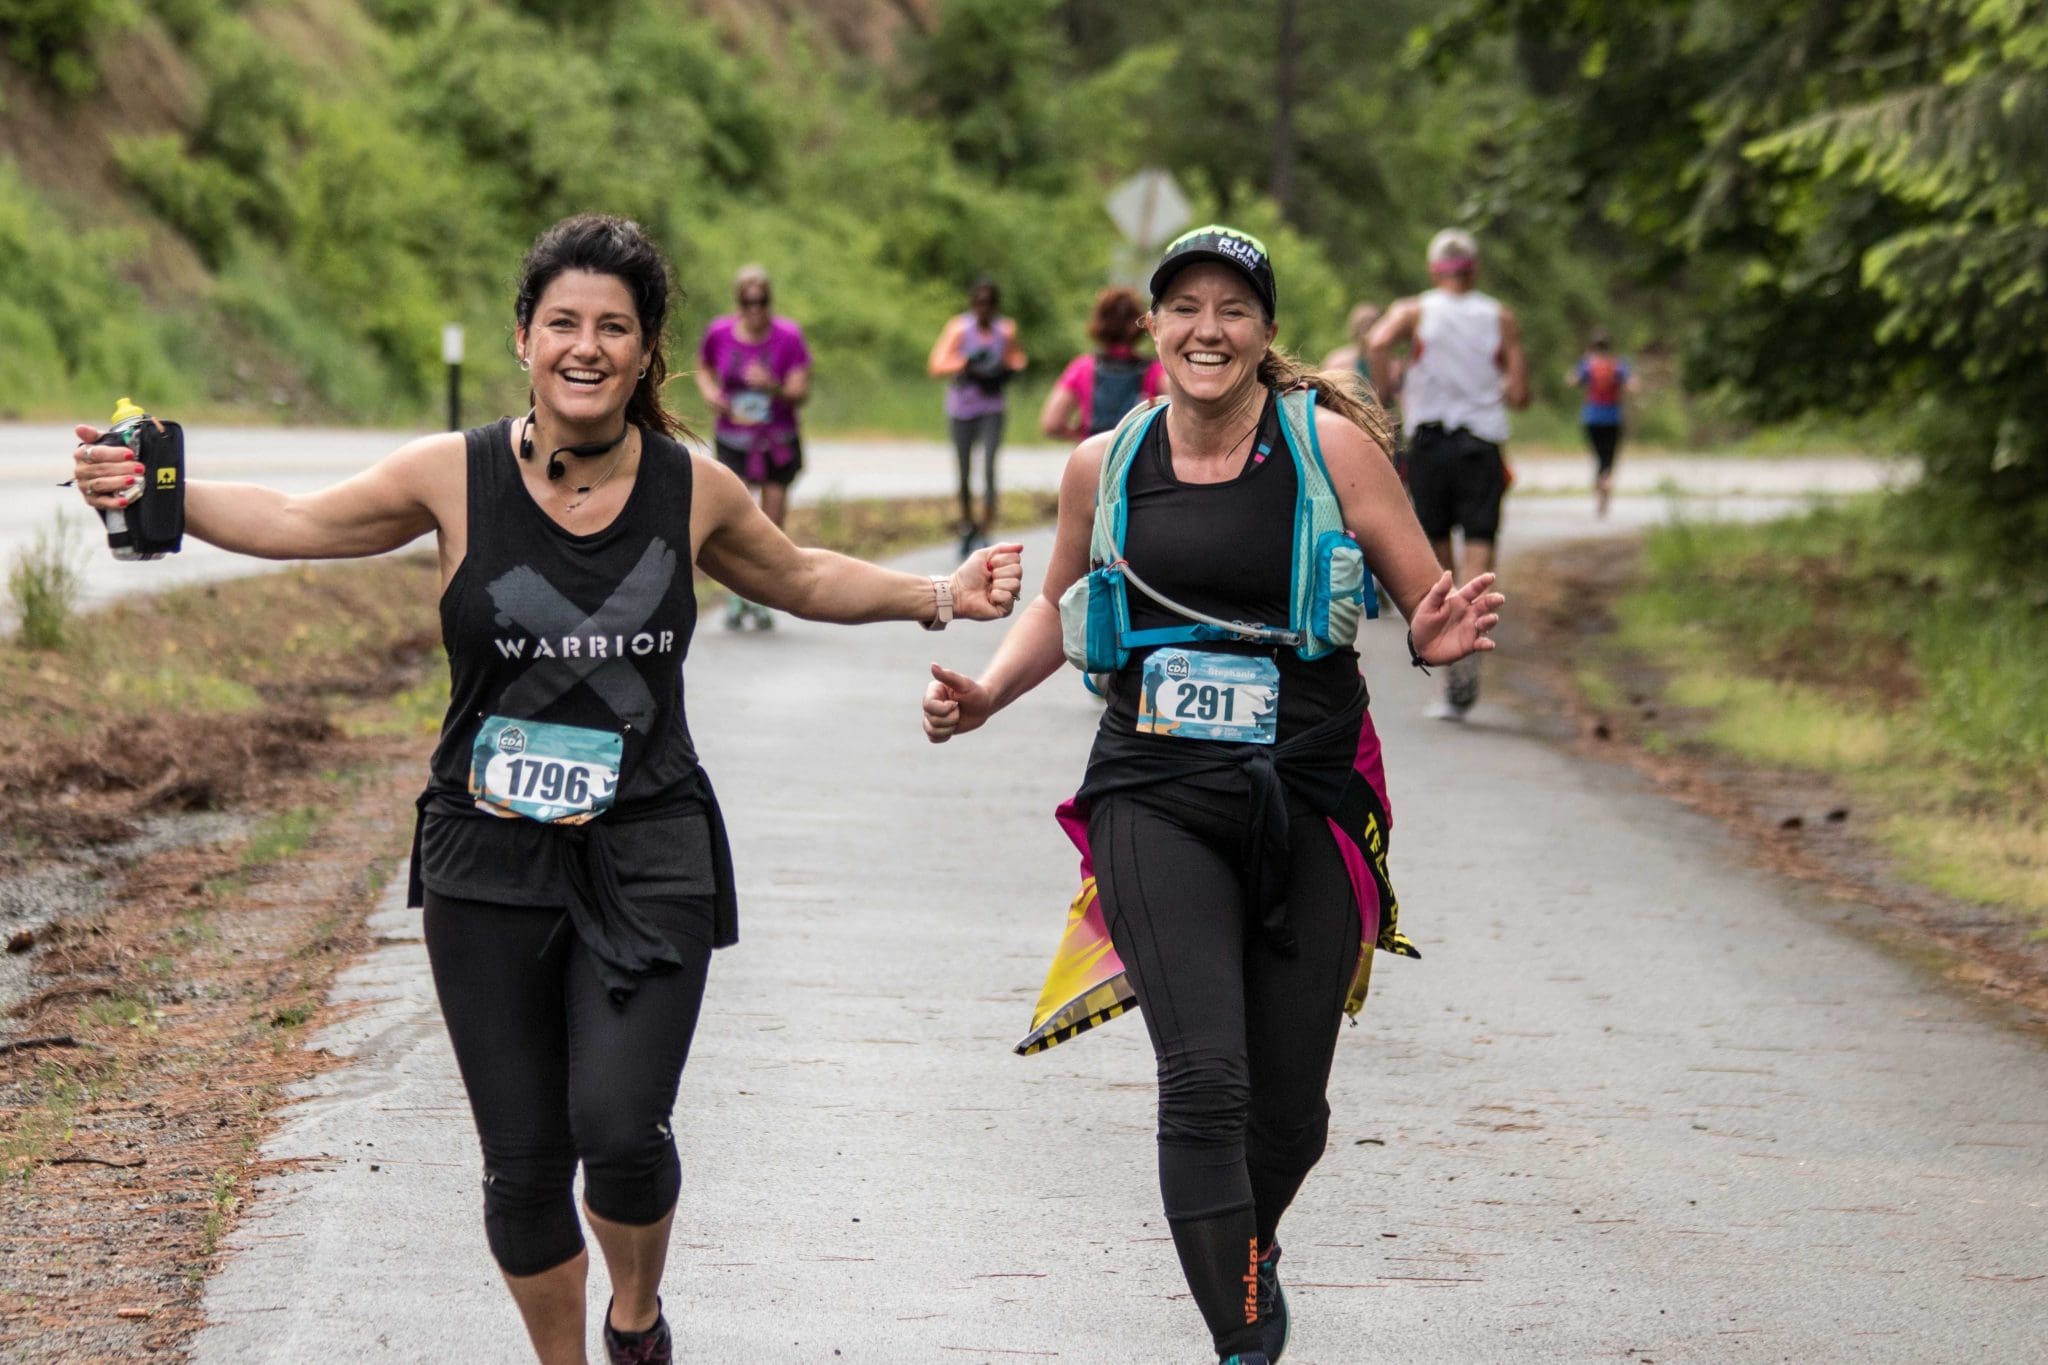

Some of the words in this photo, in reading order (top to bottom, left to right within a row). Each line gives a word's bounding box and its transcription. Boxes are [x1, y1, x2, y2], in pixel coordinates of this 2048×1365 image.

[1217, 246, 1237, 257] THE
[1236, 253, 1257, 271] PNW
[1218, 237, 1261, 264] RUN
[494, 630, 674, 659] WARRIOR
[1167, 664, 1188, 674] CDA
[1207, 666, 1257, 680] Stephanie
[1175, 682, 1235, 722] 291
[500, 736, 523, 747] CDA
[506, 758, 591, 805] 1796
